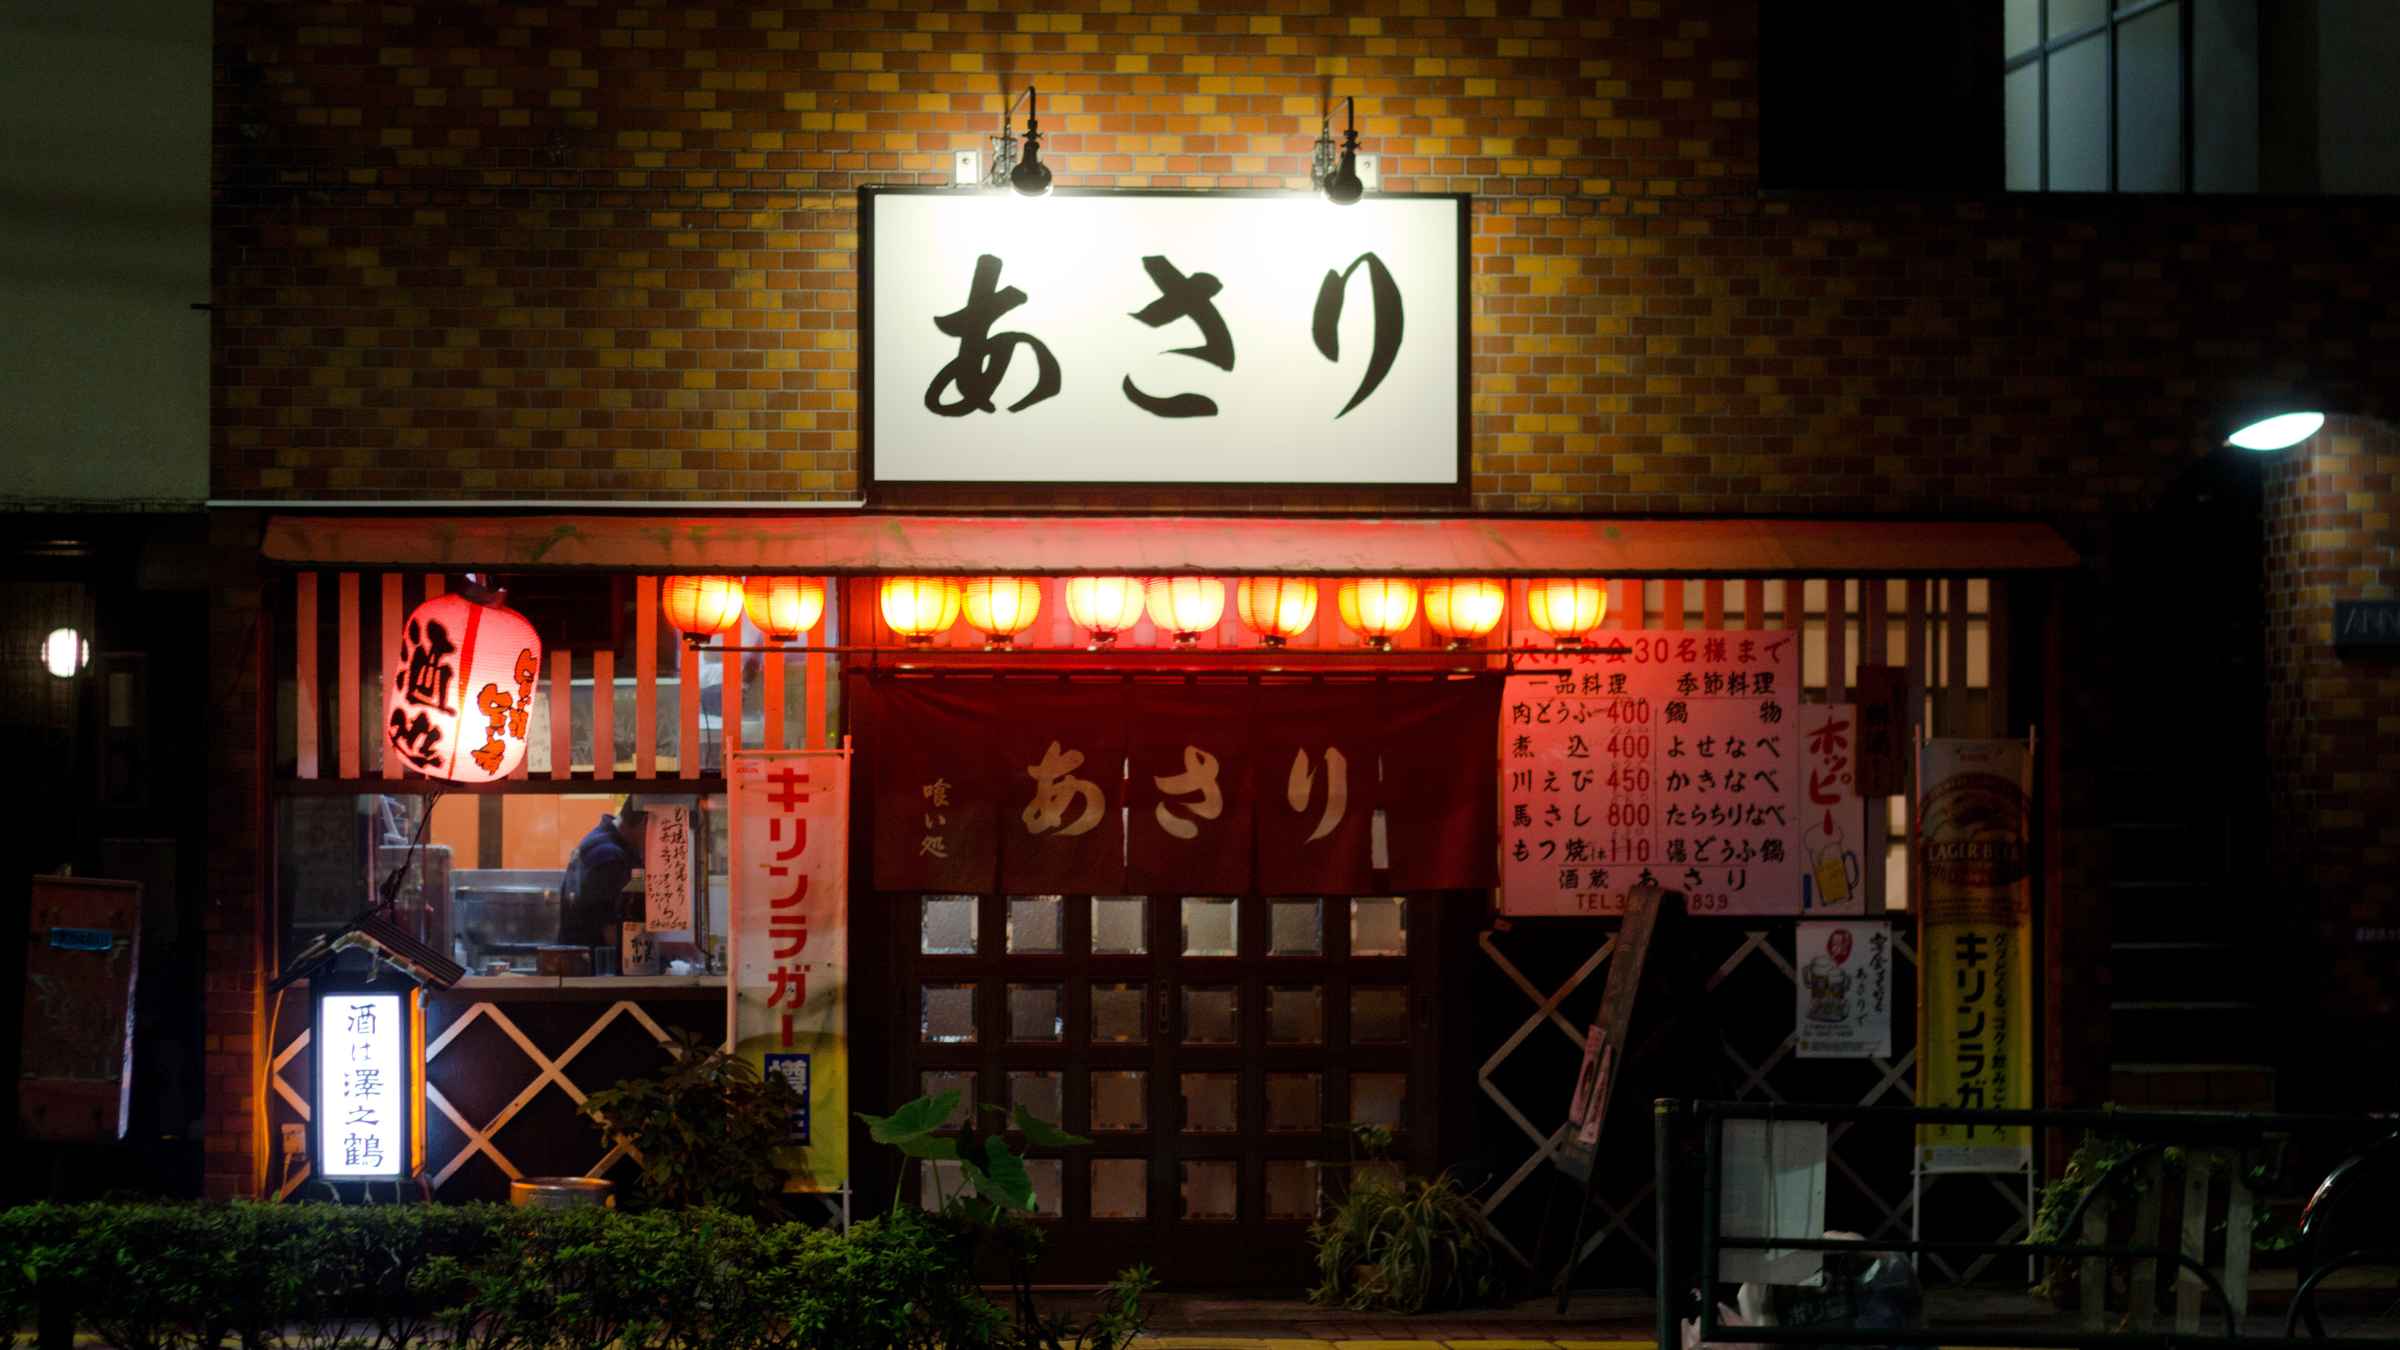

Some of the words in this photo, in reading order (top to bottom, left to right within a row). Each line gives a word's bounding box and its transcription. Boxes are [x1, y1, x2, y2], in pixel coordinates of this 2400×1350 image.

[925, 251, 1404, 420] あさり
[1528, 672, 1628, 696] 一品料理
[1677, 671, 1776, 697] 季節料理
[1512, 698, 1593, 725] 肉どうふ
[1607, 699, 1650, 725] 400
[1512, 735, 1591, 759] 煮込
[1607, 735, 1650, 759] 400
[1667, 736, 1781, 759] よせなべ
[1512, 769, 1594, 793] 川えび
[1607, 769, 1650, 792] 450
[1666, 769, 1780, 793] かきなべ
[1808, 715, 1858, 837] ホッピー
[1021, 741, 1348, 845] あさり
[919, 778, 952, 859] 喰い処
[1512, 804, 1592, 827] 馬さし
[1608, 803, 1650, 827] 800
[1666, 803, 1787, 827] たらちりなべ
[1512, 838, 1588, 862] もつ焼
[1611, 838, 1650, 862] 110
[1667, 836, 1786, 864] 湯どうふ鍋
[1559, 868, 1609, 889] 酒蔵
[1639, 867, 1746, 892] あさり
[766, 767, 811, 1048] キリンラガー
[1956, 932, 1989, 1139] キリンラガー
[343, 1003, 385, 1169] 酒は澤之鶴
